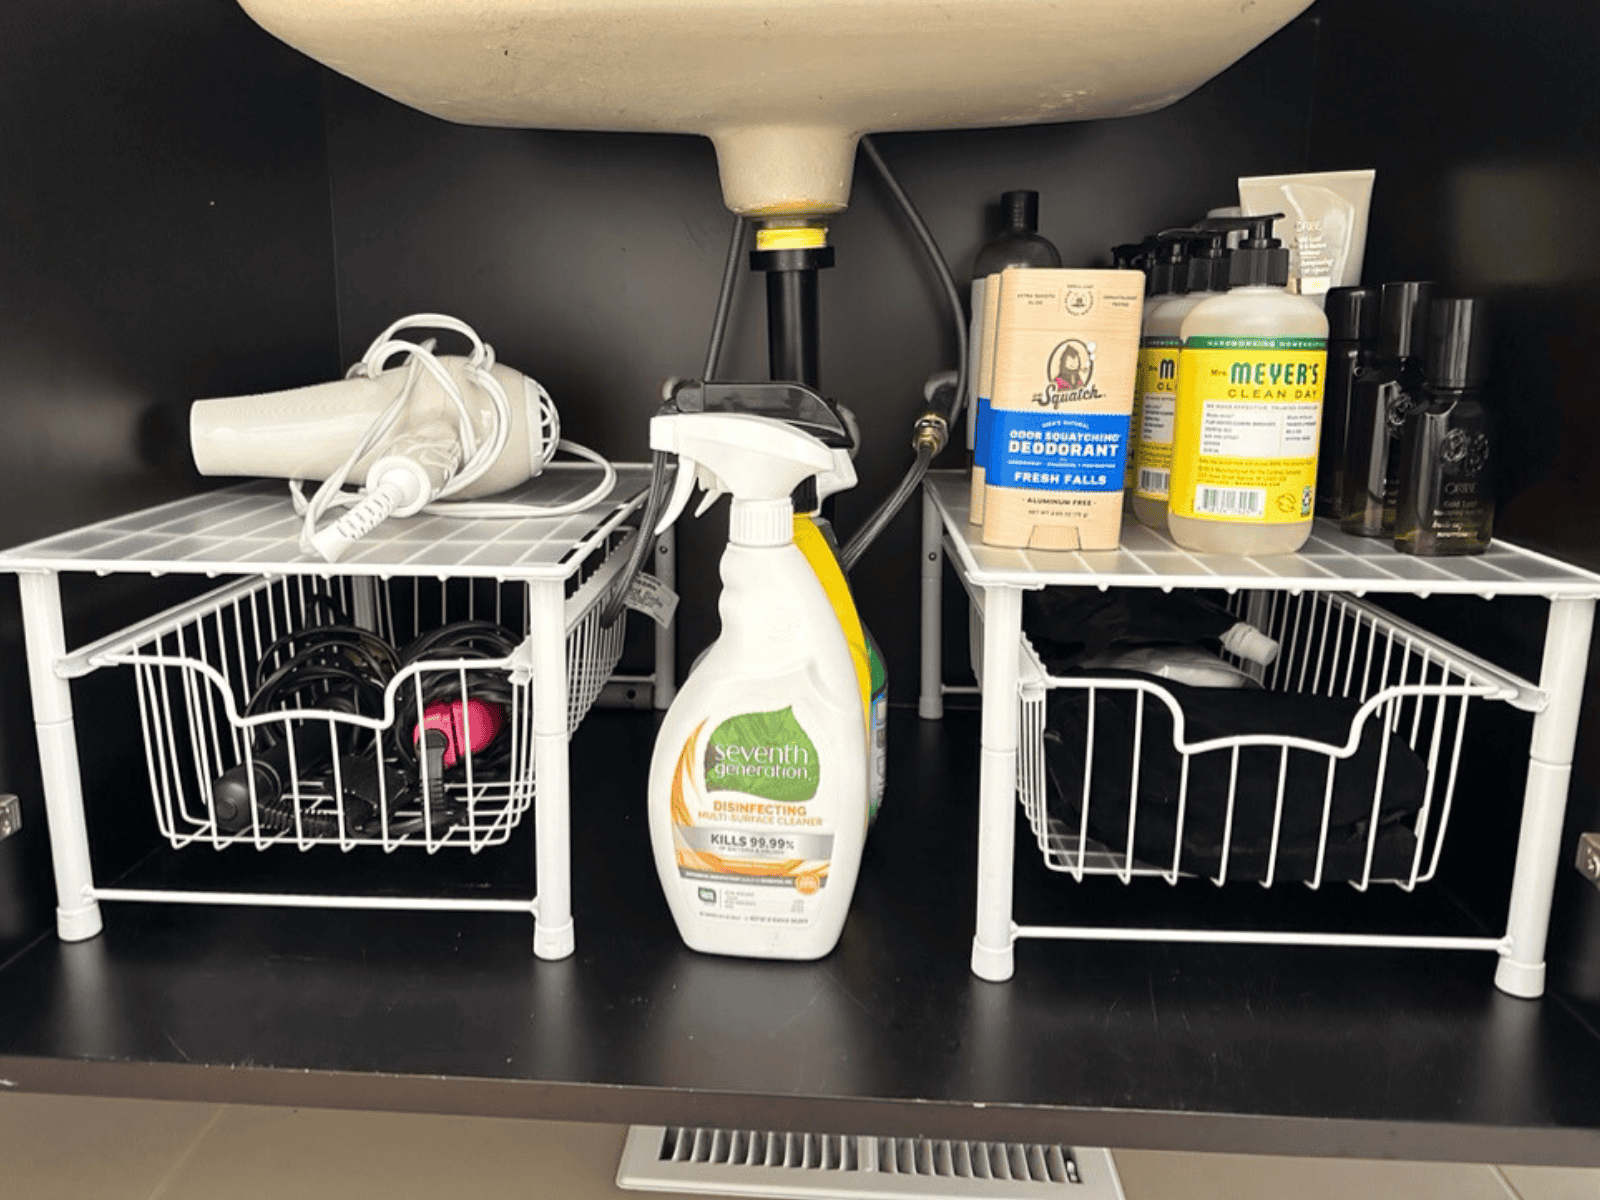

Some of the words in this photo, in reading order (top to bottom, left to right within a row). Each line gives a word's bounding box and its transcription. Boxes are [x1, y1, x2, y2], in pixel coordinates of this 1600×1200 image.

[1231, 361, 1320, 386] MEYER'S
[1033, 384, 1103, 410] Squatch
[1228, 388, 1288, 399] CLEAN
[1294, 389, 1318, 399] DAY
[1009, 429, 1042, 440] ODOR
[1044, 431, 1121, 442] SQUATCHING
[1008, 440, 1120, 457] DEODORANT
[1014, 471, 1060, 484] FRESH
[1064, 474, 1107, 485] FALLS
[1026, 497, 1071, 506] ALUMINUM
[714, 743, 808, 765] seventh
[713, 800, 807, 816] DISINFECTING
[698, 810, 773, 825] MULTI-SURFACE
[776, 816, 823, 827] CLEANER
[711, 833, 747, 848] KILLS
[749, 836, 794, 851] 99.99%
